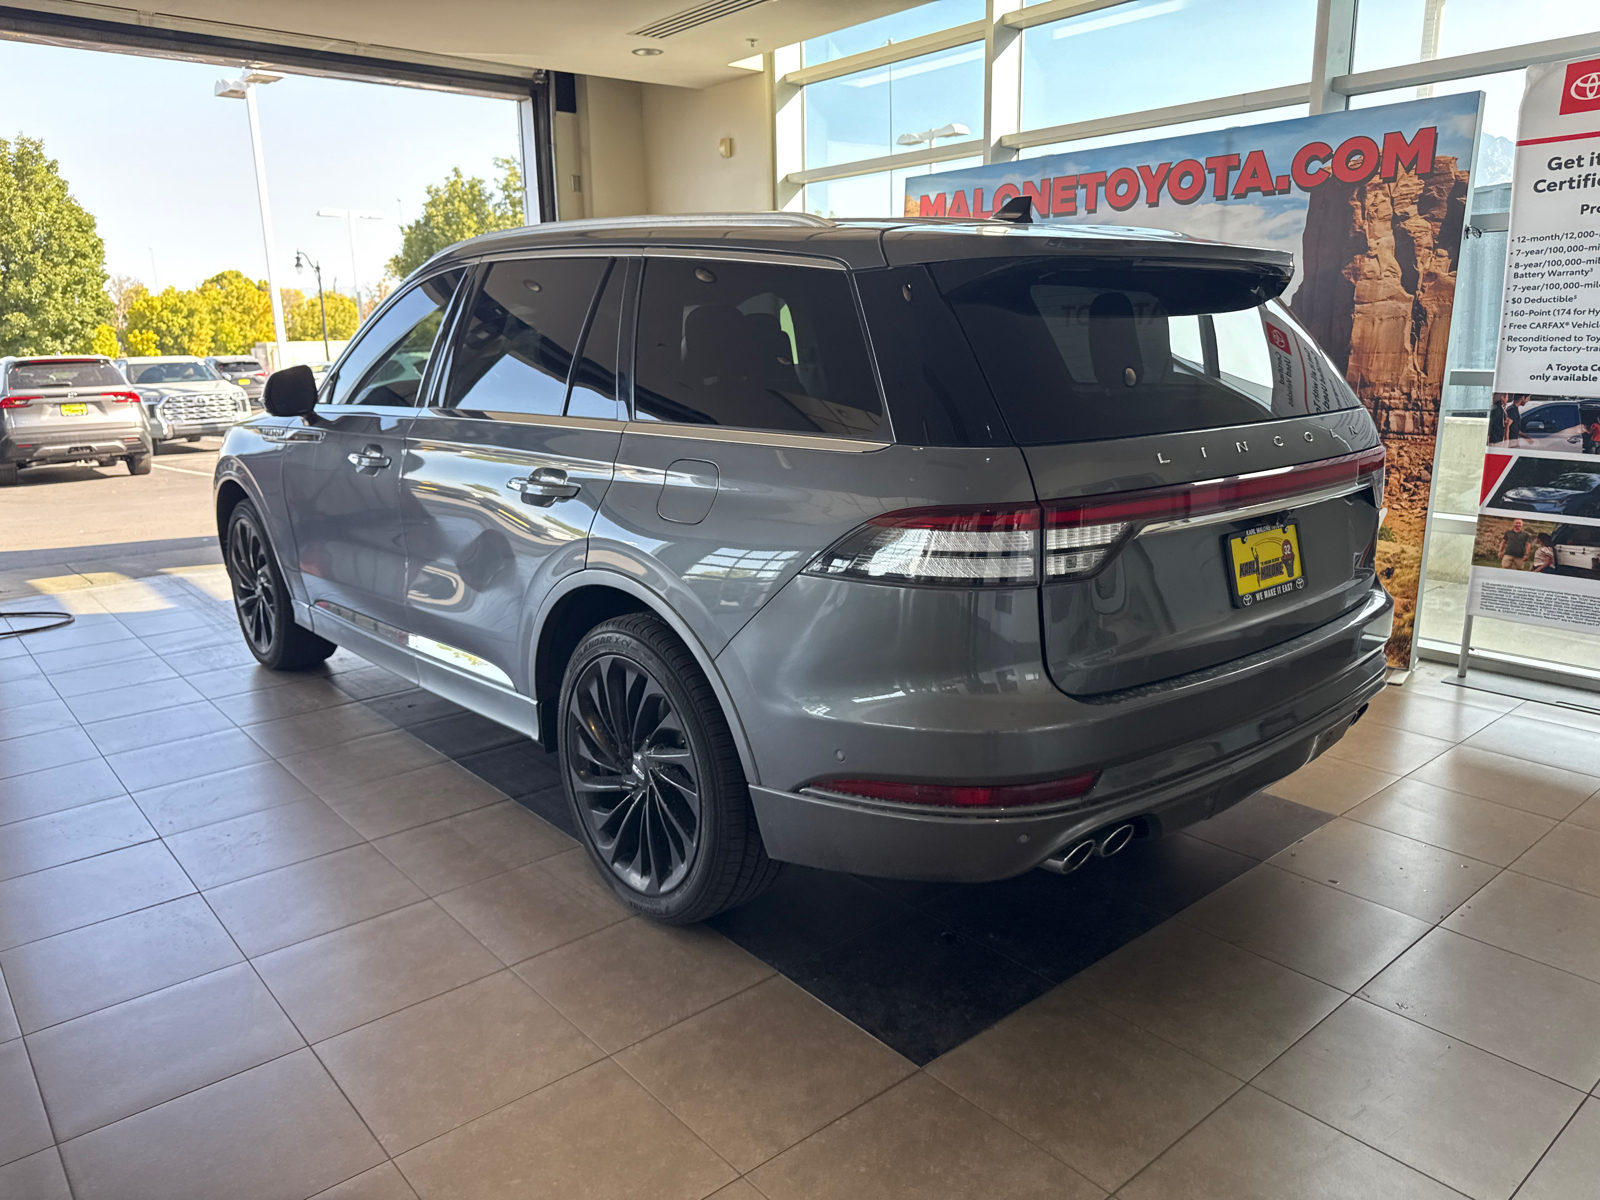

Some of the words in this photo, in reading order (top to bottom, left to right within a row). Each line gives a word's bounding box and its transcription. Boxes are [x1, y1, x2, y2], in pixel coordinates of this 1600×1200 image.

[1548, 154, 1584, 171] Get
[919, 126, 1438, 218] MALONETOYOTA.COM
[1533, 172, 1600, 193] Certifi
[1514, 270, 1545, 279] Battery
[1512, 281, 1600, 292] 7-year/100,000-mil
[1553, 308, 1571, 317] (174
[1506, 345, 1517, 353] by
[1519, 345, 1548, 353] Toyota
[1555, 364, 1588, 372] Toyota
[1529, 373, 1550, 382] only
[1552, 374, 1598, 382] available
[1156, 424, 1358, 464] LINCOLN
[1284, 544, 1291, 555] 32
[1240, 560, 1256, 578] KARL
[1261, 562, 1284, 581] MALONE
[1256, 593, 1263, 601] WE
[1264, 588, 1276, 599] MAKE
[1282, 582, 1293, 593] EASY
